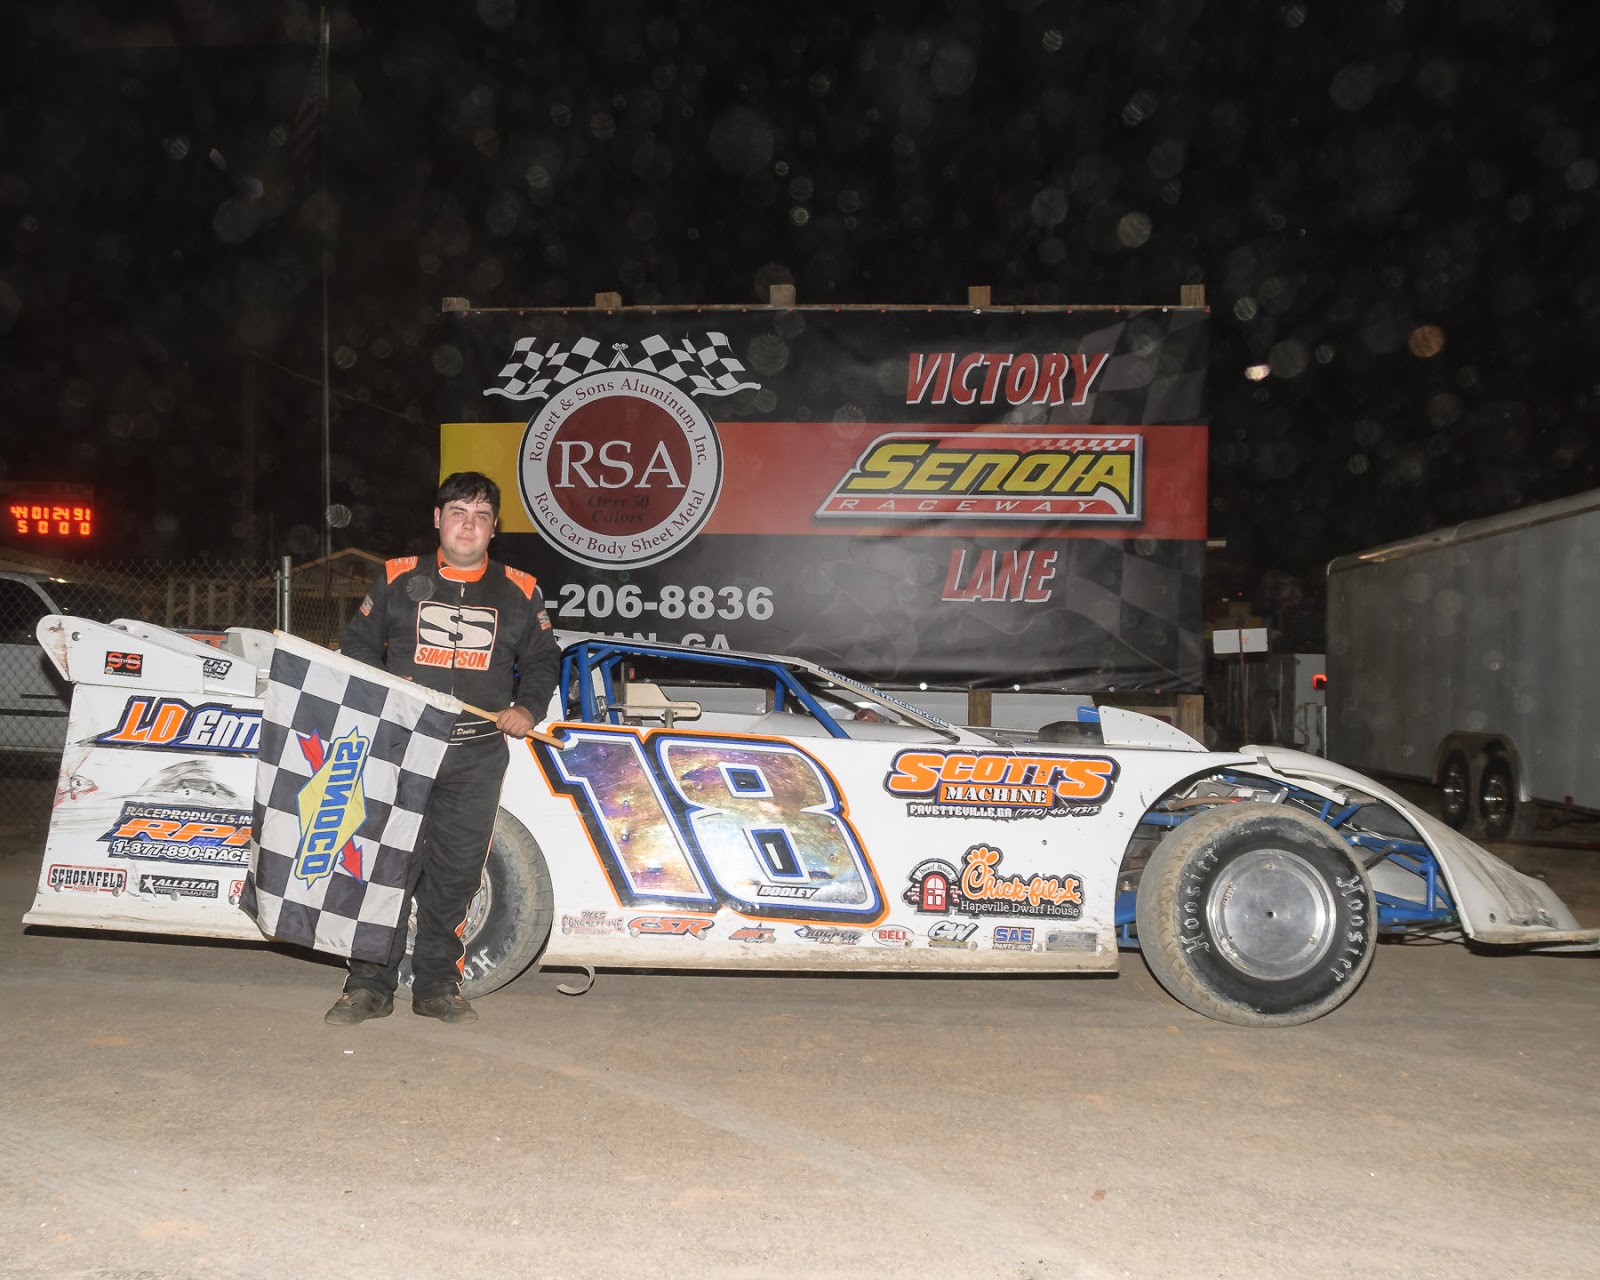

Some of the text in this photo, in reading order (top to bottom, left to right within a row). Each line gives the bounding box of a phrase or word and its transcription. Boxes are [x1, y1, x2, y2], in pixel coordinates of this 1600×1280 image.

[906, 352, 1109, 406] VICTORY
[529, 377, 708, 466] Robert & Sons Aluminum, Inc.
[554, 440, 686, 489] RSA
[846, 443, 1132, 506] SENOIA
[838, 500, 1096, 513] RACEWAY
[533, 489, 706, 558] Race Car Body Sheet Metal
[941, 549, 1058, 603] LANE
[535, 583, 774, 620] -206-8836
[417, 647, 487, 668] SIMPSON
[946, 785, 1048, 803] MACHINE
[548, 731, 880, 914] 18
[51, 868, 124, 888] SCHOENFELD
[155, 878, 217, 890] ALLSTAR
[758, 886, 817, 898] DOOLEY
[961, 857, 1082, 907] Chick-fil-A
[961, 901, 1079, 916] Hapeville Dwarf House
[878, 929, 908, 940] BELL
[995, 928, 1033, 942] SAE
